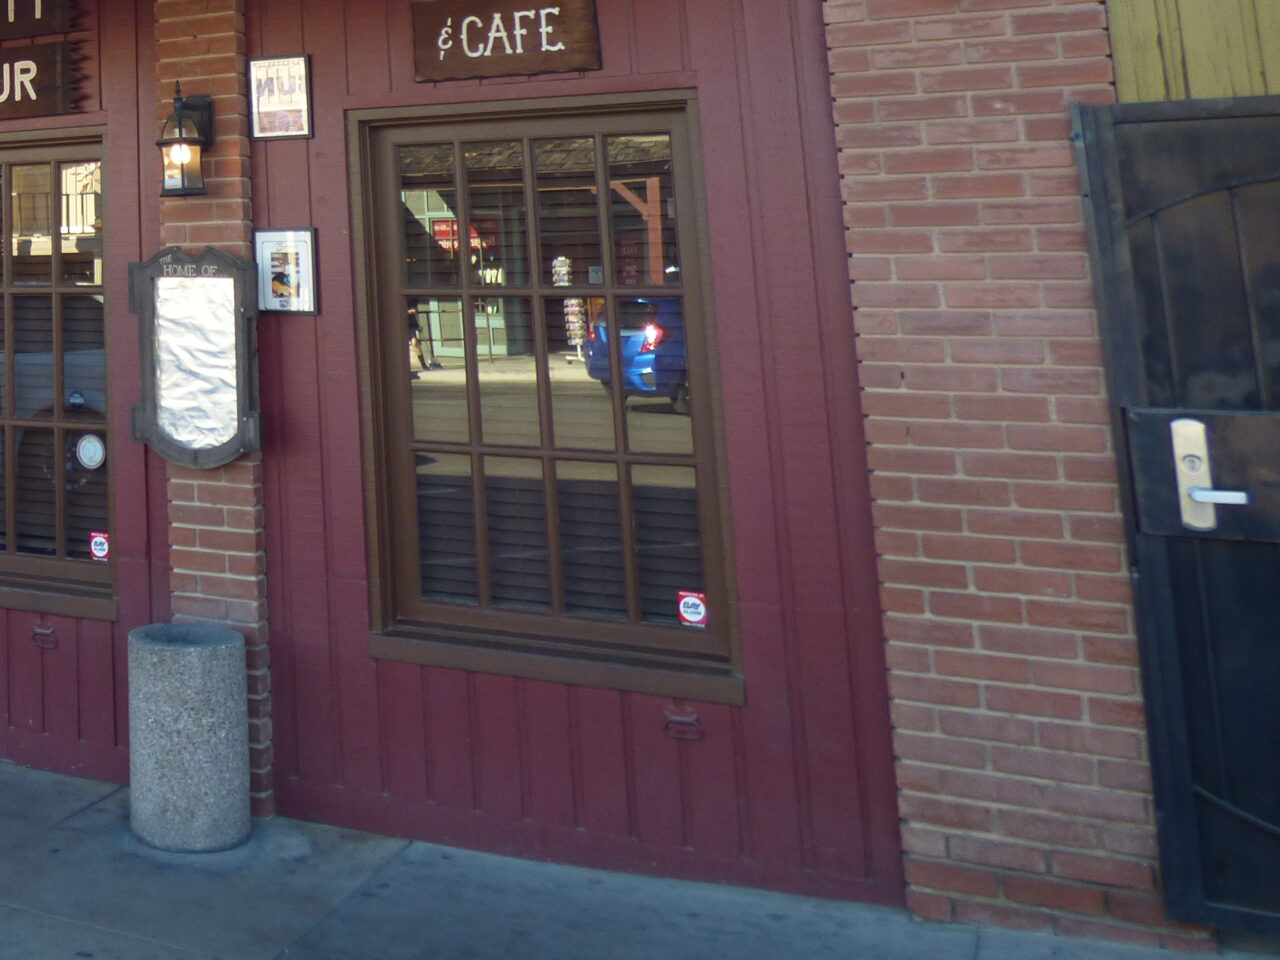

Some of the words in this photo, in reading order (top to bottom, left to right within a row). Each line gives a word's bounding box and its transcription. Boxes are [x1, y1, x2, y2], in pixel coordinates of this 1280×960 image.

[460, 7, 566, 58] CAFE
[159, 254, 172, 264] THE
[163, 264, 197, 276] HOME
